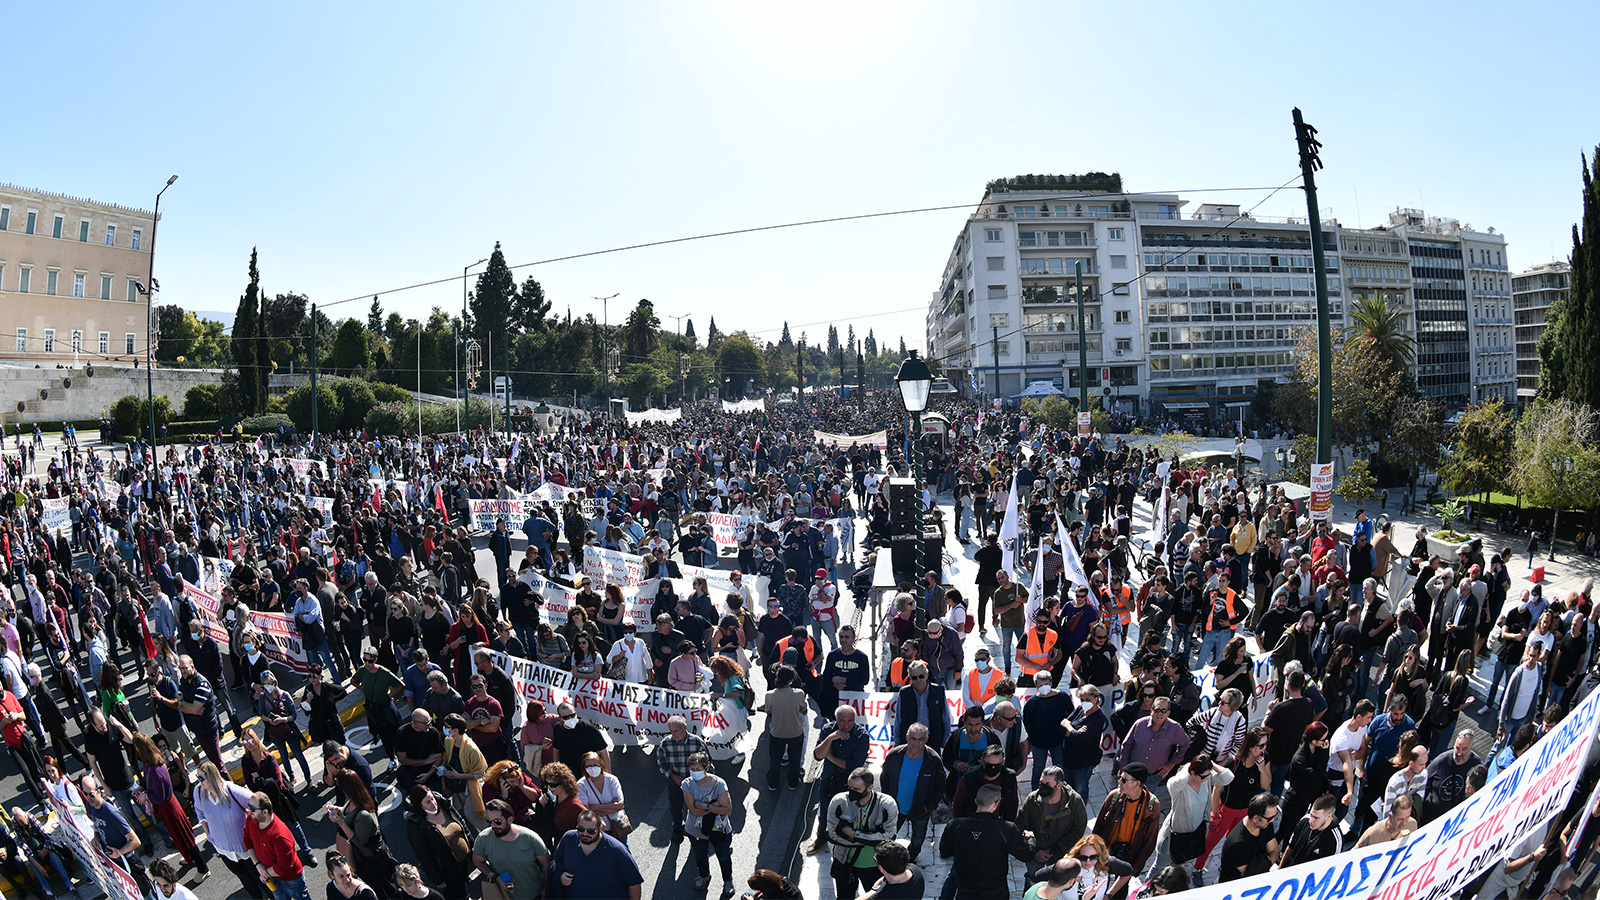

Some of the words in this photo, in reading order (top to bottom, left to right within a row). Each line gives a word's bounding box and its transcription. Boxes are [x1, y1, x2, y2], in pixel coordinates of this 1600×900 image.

[473, 501, 522, 514] ΔΙΕΚΔΙΚΟΥΜΕ
[476, 521, 497, 532] ΣΩΜΑΤ
[506, 521, 523, 533] ΕΡΓΑΖ
[511, 661, 568, 690] ΜΠΑΙΝΕΙ
[568, 676, 579, 691] Η
[579, 680, 608, 697] ΖΩΗ
[612, 683, 639, 704] ΜΑΣ
[643, 688, 661, 706] ΣΕ
[635, 706, 643, 721] Η
[1426, 797, 1481, 855] ΜΕ
[1480, 758, 1530, 819] ΤΗΝ
[1446, 796, 1520, 870] ΣΤΟΥΣ
[1514, 735, 1589, 820] ΜΙΣΘΟΥΣ
[1505, 780, 1571, 851] ΕΛΛΑΔΑΣ
